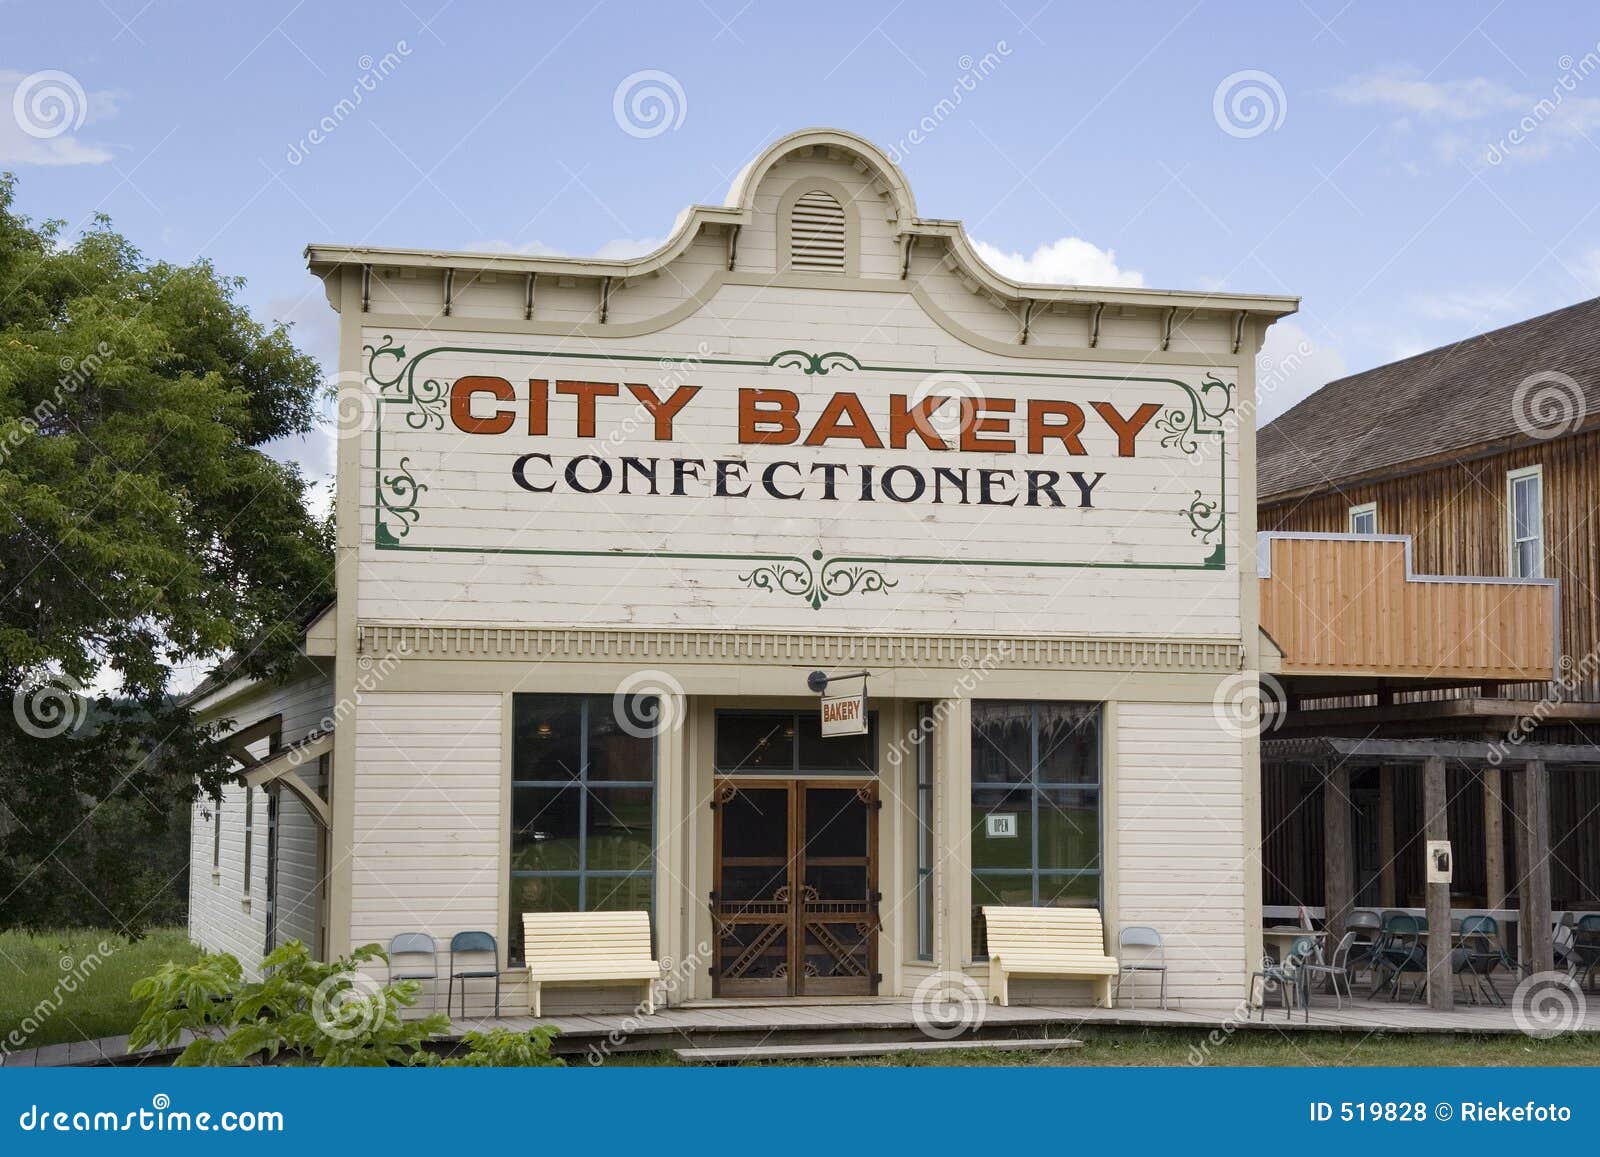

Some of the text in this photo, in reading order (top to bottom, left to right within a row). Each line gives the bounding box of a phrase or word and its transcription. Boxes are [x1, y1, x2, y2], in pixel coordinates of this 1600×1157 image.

[450, 375, 1164, 458] CITY BAKERY
[511, 452, 1106, 508] CONFECTIONERY
[823, 700, 861, 722] BAKERY
